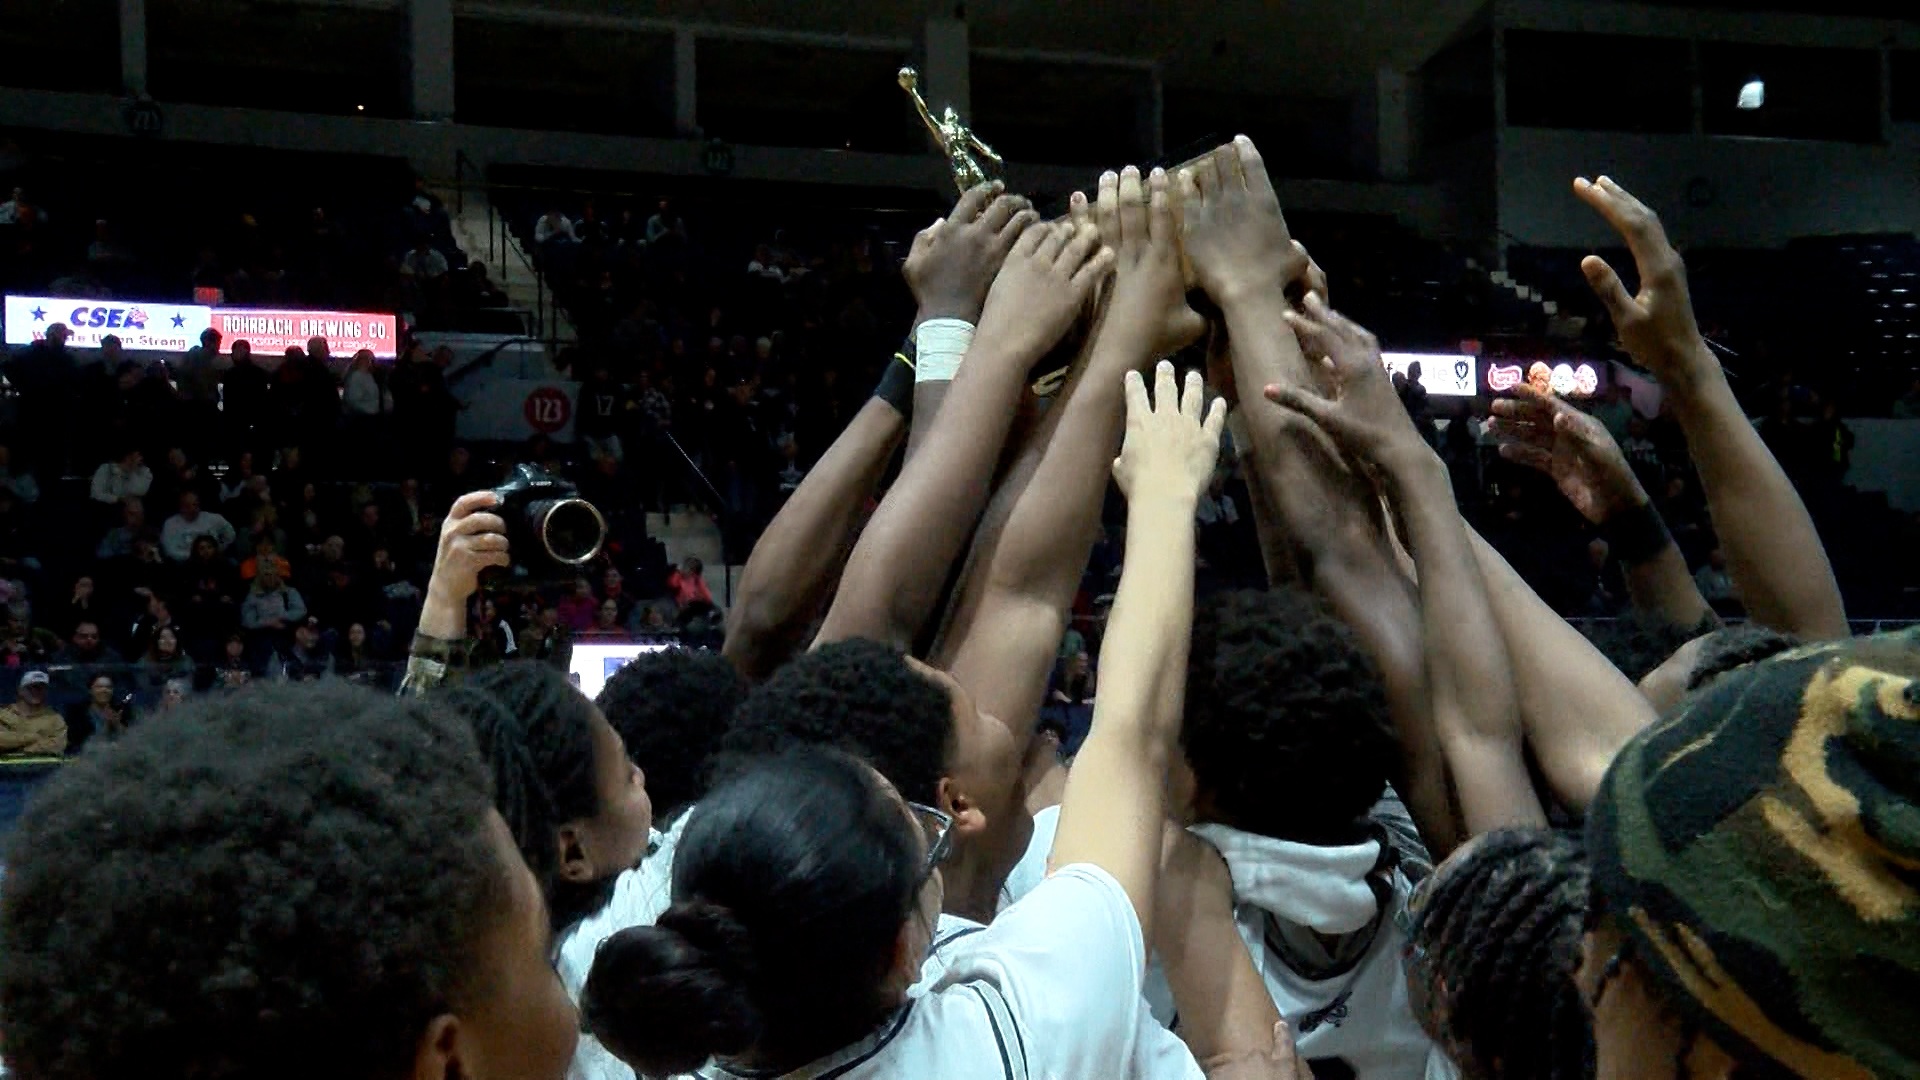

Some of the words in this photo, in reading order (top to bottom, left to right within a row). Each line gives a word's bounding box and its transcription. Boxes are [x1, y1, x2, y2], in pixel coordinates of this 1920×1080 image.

[70, 306, 147, 330] CSEA
[223, 314, 292, 336] ROHRBACH
[300, 319, 362, 338] BREWING
[368, 321, 390, 340] CO.
[139, 335, 186, 350] Strong
[535, 397, 562, 423] 123
